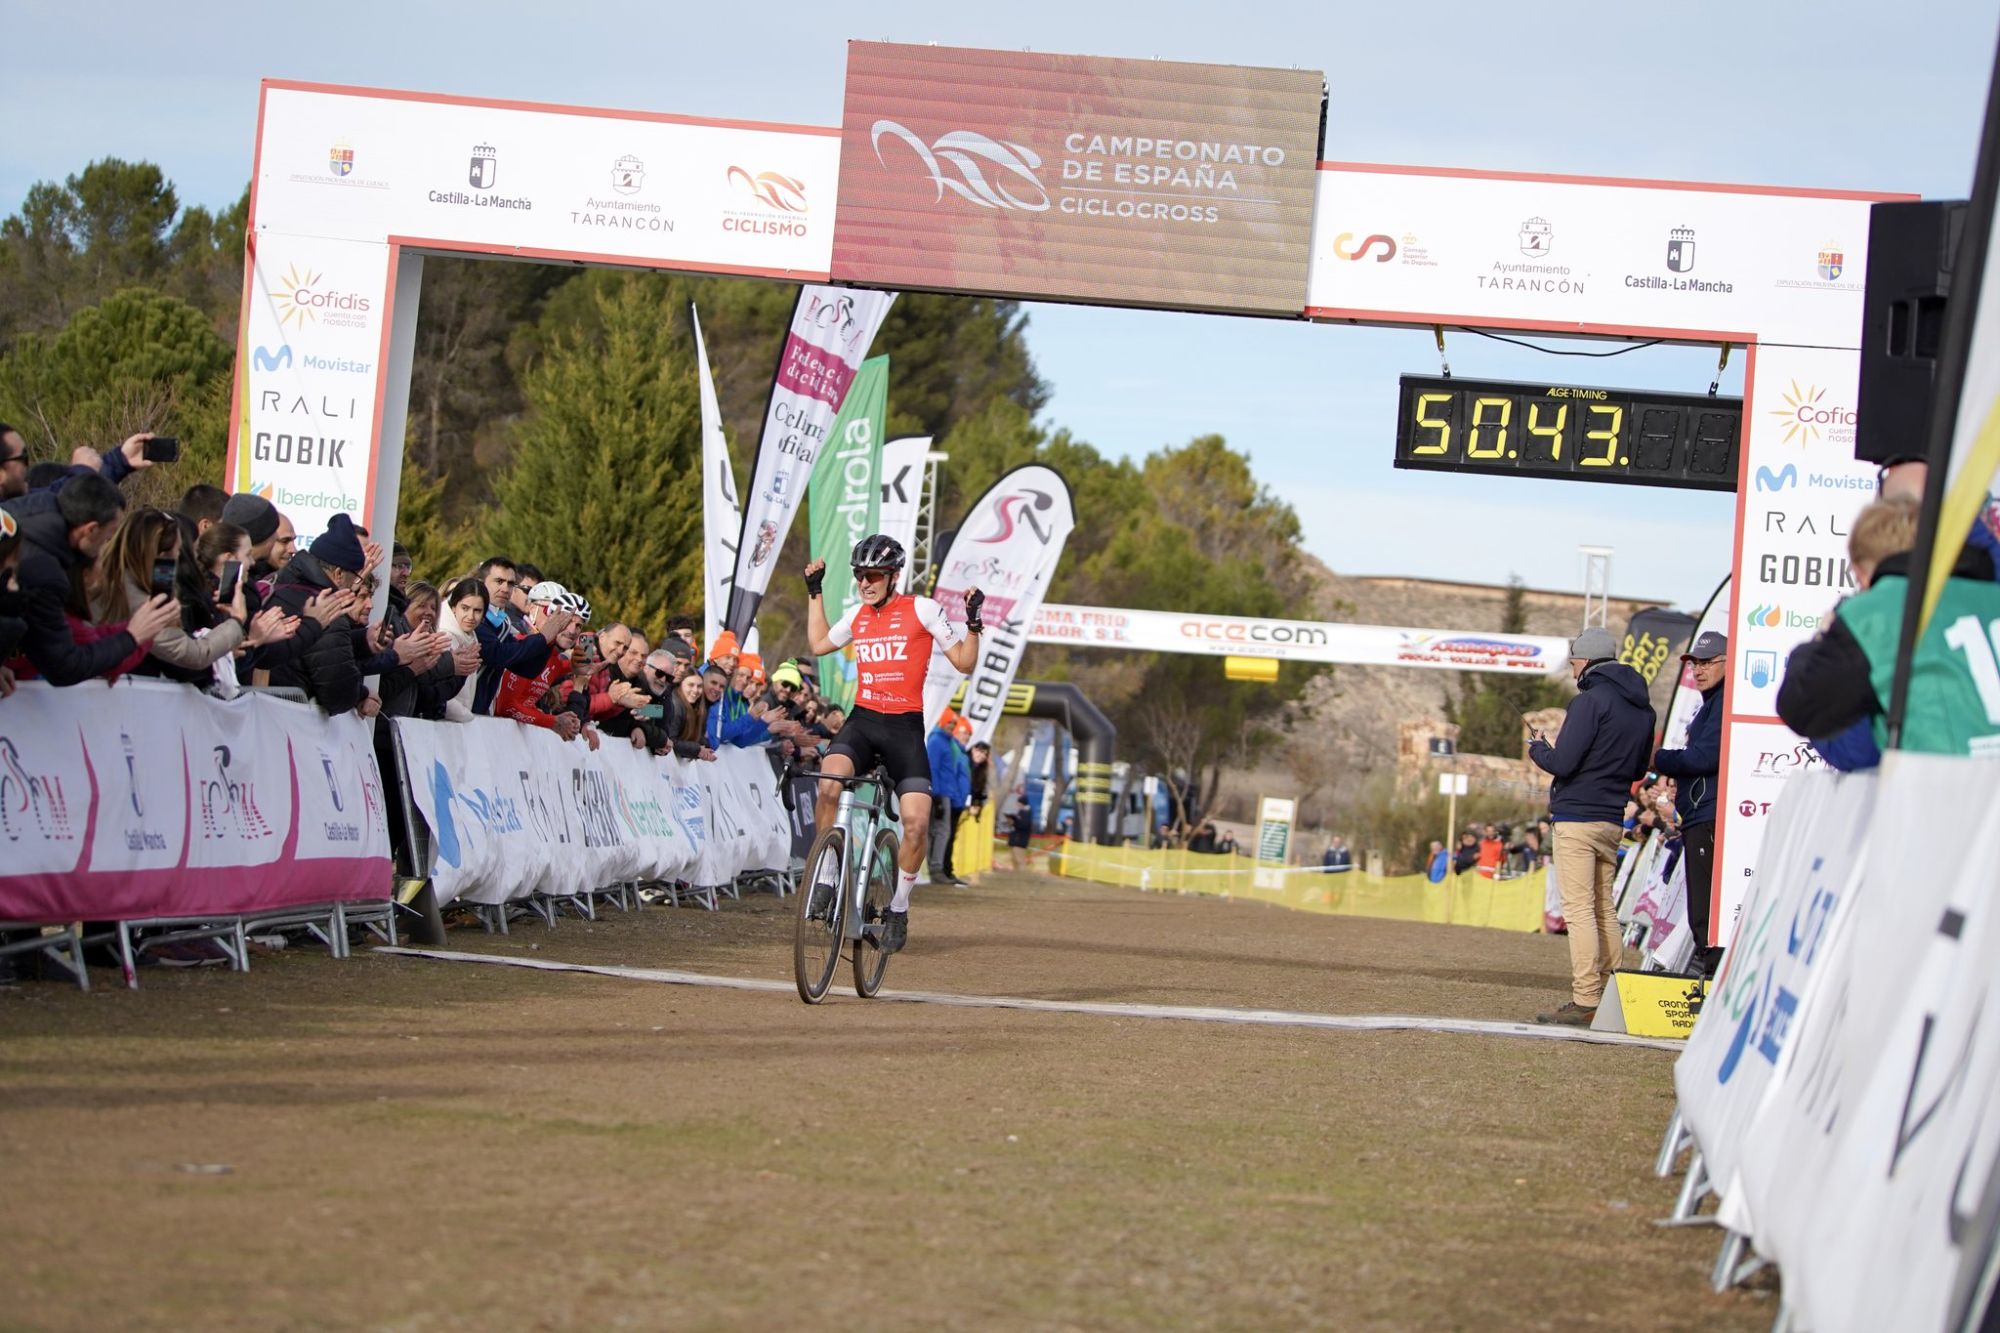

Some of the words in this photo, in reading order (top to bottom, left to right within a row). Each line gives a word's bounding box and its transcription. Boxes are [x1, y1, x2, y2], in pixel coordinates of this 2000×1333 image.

[1065, 132, 1286, 166] CAMPEONATO
[1062, 162, 1104, 182] DE
[1114, 163, 1238, 191] ESPAÑA
[586, 197, 661, 213] Ayuntamiento
[1060, 197, 1219, 223] CICLOCROSS
[571, 211, 674, 232] TARANCÓN
[722, 217, 807, 237] CICLISMO
[1493, 261, 1570, 275] Ayuntamiento
[1477, 275, 1584, 294] TARANCÓN
[295, 289, 370, 311] Cofidis
[323, 318, 367, 328] nosotros
[303, 354, 372, 374] Movistar
[1546, 387, 1608, 400] ALGE-TIMING
[261, 390, 356, 419] RALI
[1797, 406, 1858, 425] Cofid
[254, 432, 345, 468] GOBIK
[277, 488, 358, 511] Iberdrola
[1765, 511, 1848, 536] RAL
[1759, 553, 1855, 589] GOBIK
[1028, 623, 1082, 637] ALOR
[968, 616, 1024, 722] GOBIK
[1672, 1019, 1696, 1029] RADI
